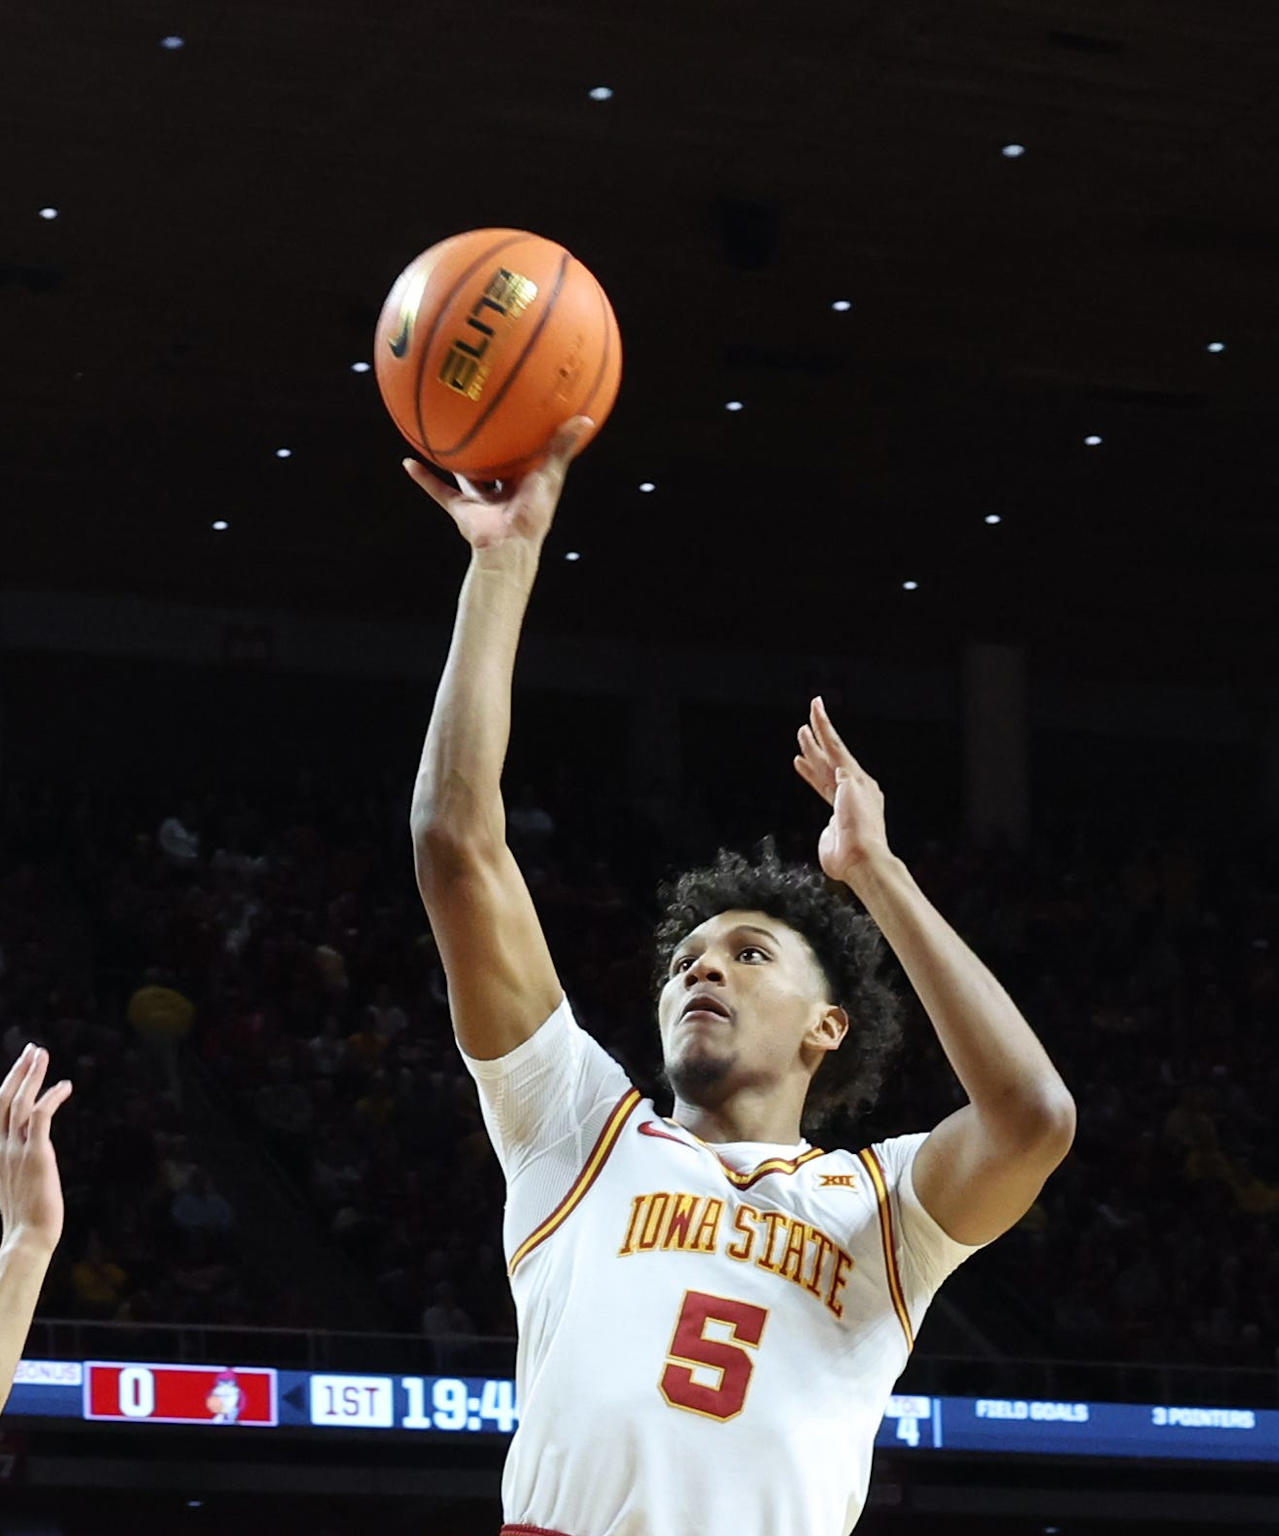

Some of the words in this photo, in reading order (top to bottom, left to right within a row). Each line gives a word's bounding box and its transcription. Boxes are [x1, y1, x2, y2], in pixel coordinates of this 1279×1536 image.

[617, 1191, 725, 1259] IOWA
[726, 1200, 855, 1320] STATE
[657, 1288, 770, 1424] 5
[119, 1367, 155, 1418] 0
[323, 1384, 381, 1417] 1ST
[400, 1376, 518, 1432] 19:4
